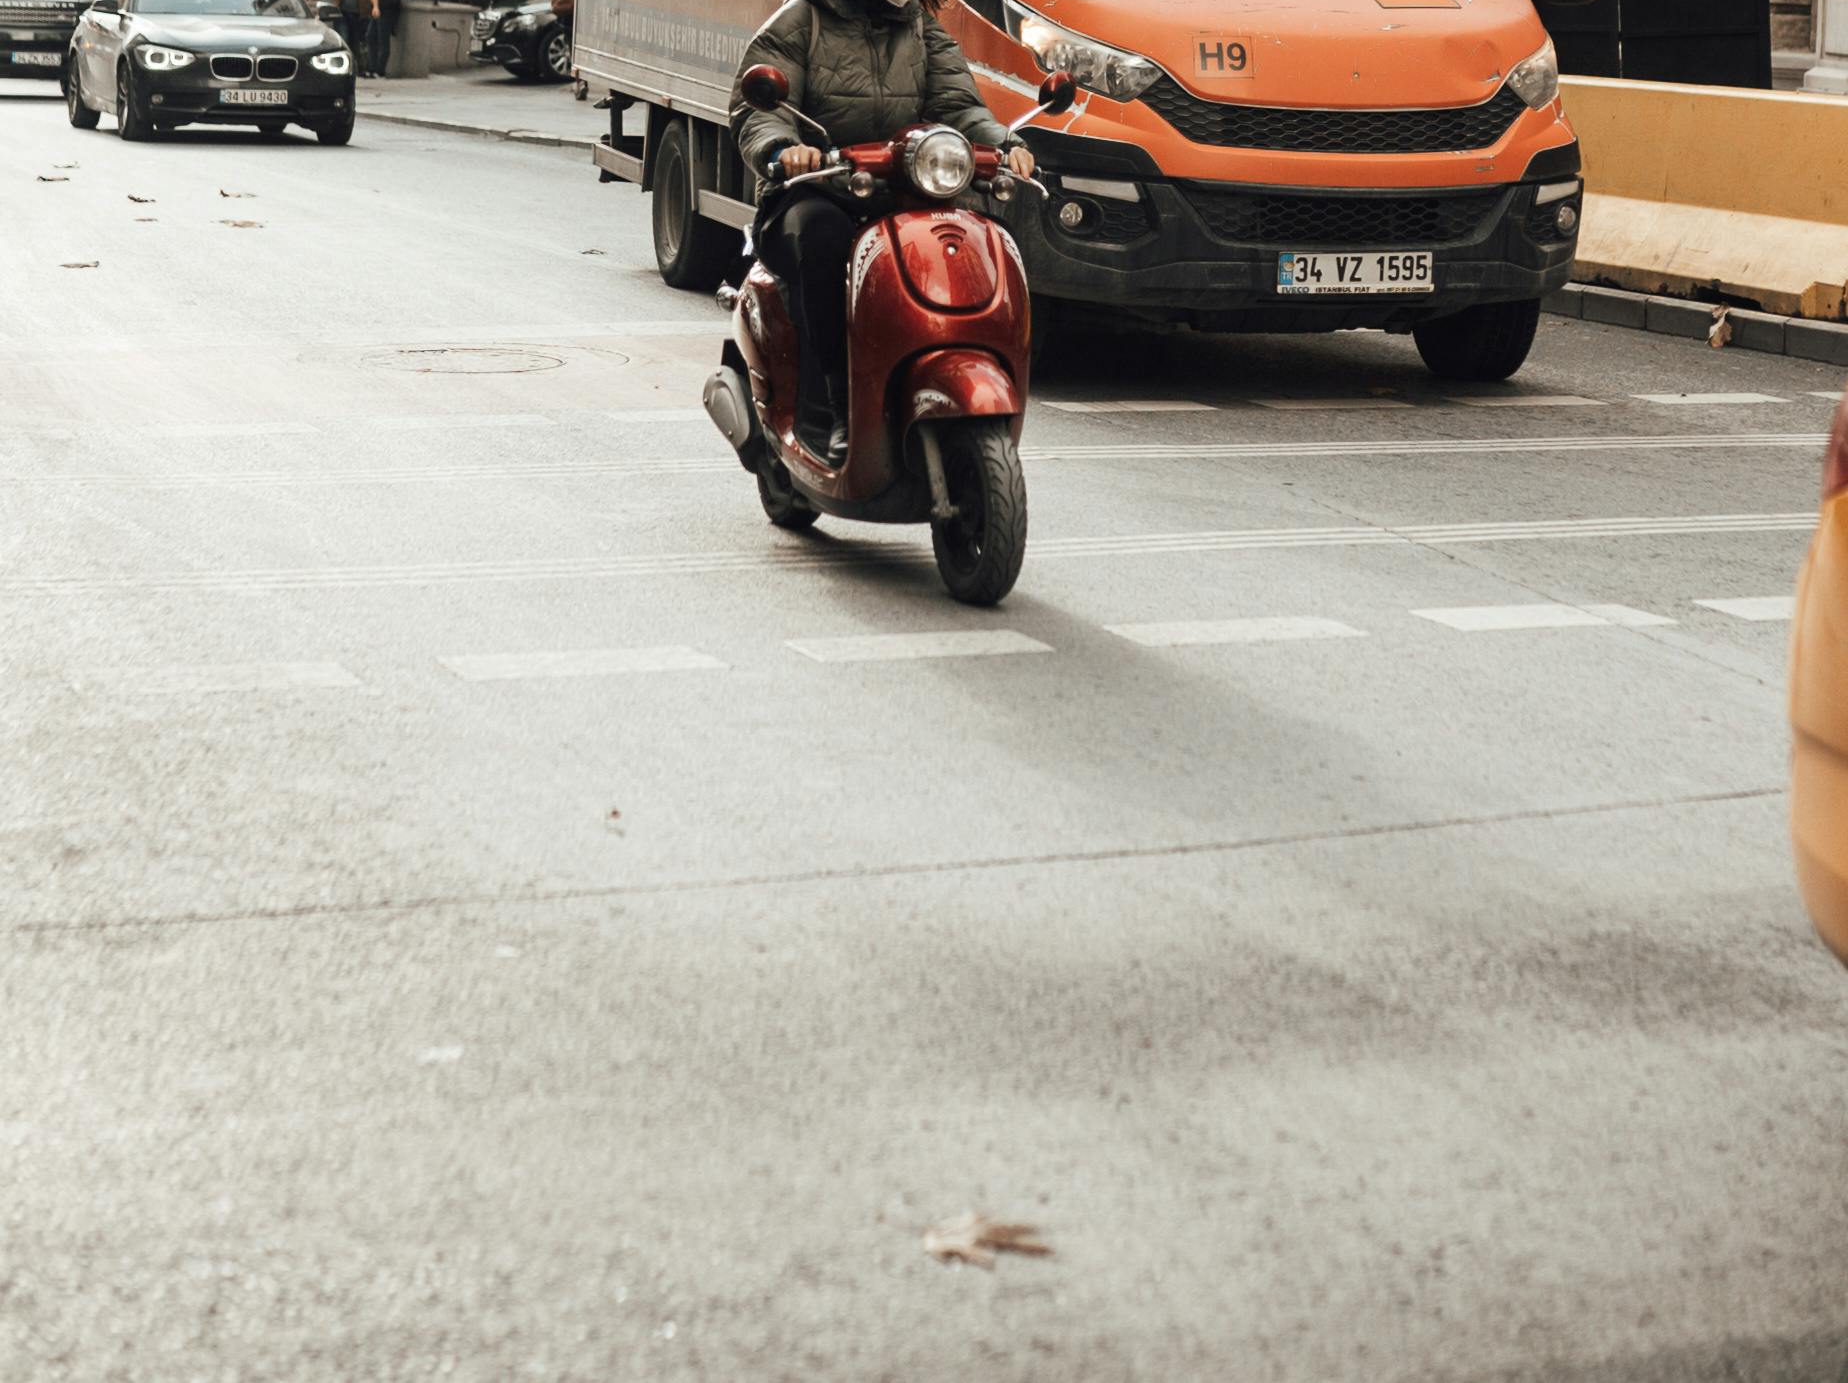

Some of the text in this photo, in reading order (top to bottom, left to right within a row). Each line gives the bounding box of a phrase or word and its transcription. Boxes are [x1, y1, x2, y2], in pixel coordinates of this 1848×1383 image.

[1200, 43, 1247, 71] H9
[226, 91, 287, 103] 34 LU 9430
[1295, 255, 1427, 282] 34 VZ 1595
